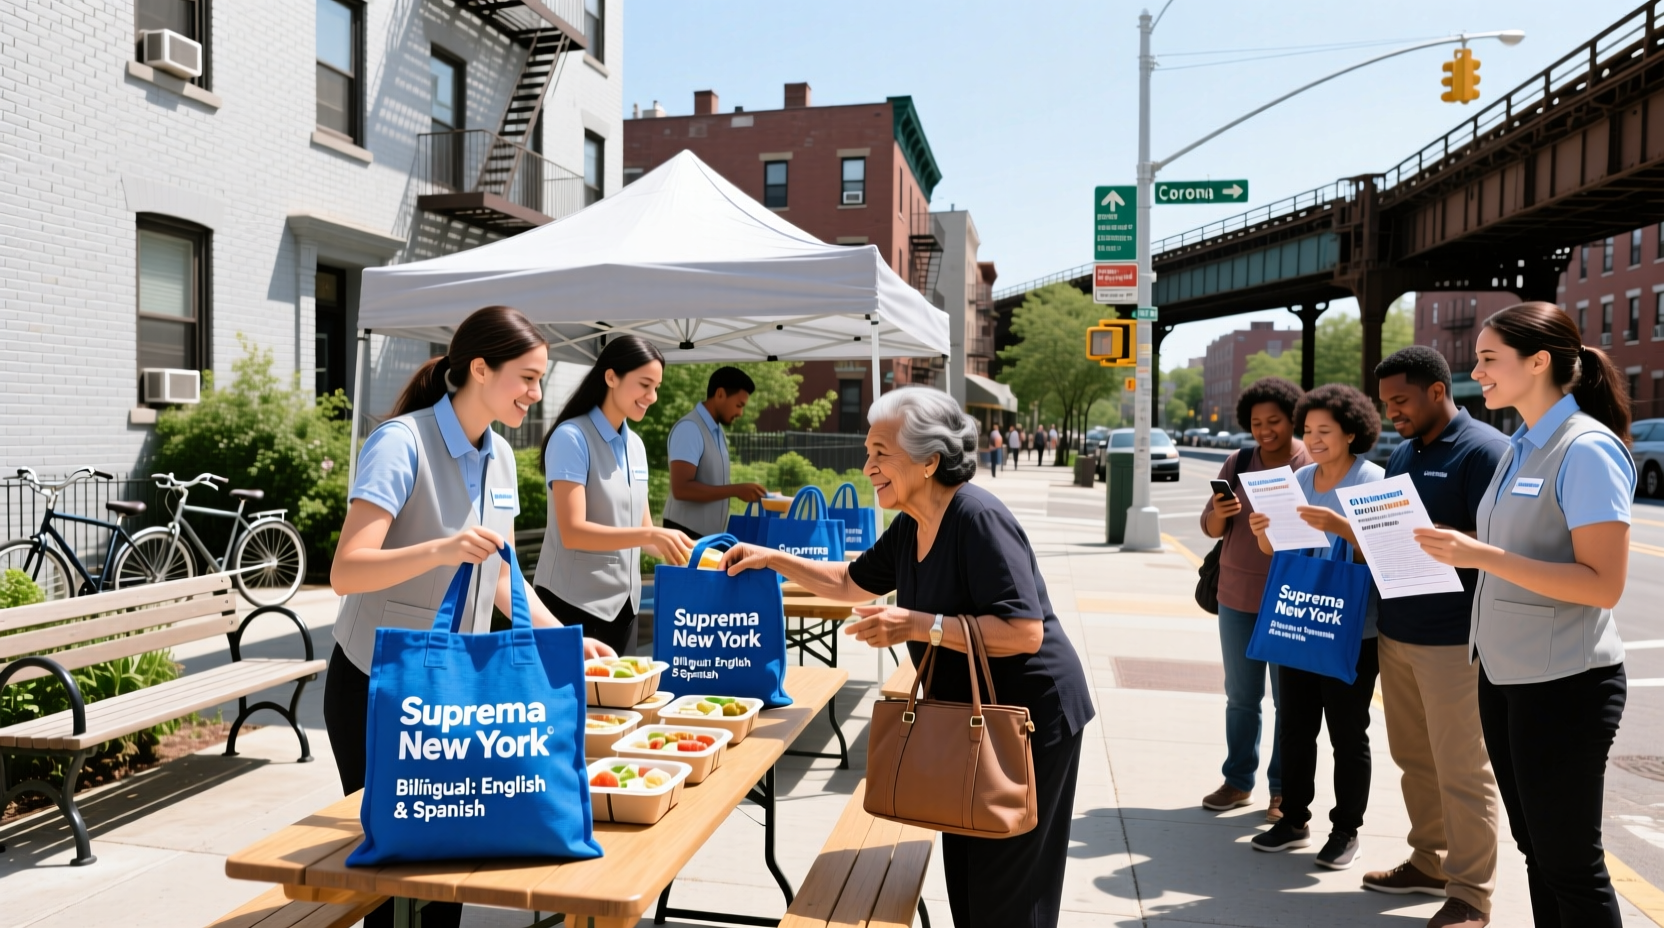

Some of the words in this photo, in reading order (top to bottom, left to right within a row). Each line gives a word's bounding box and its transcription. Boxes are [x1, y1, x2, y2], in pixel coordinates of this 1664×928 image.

[1159, 185, 1214, 201] Corona
[1279, 584, 1344, 609] Suprema
[674, 608, 759, 632] Suprema
[1275, 600, 1307, 618] New
[1309, 607, 1342, 625] York
[673, 629, 714, 648] New
[717, 628, 761, 648] York
[400, 696, 546, 733] Suprema
[399, 730, 471, 760] New
[481, 774, 546, 798] English
[394, 801, 408, 819] &
[413, 799, 485, 822] Spanish
